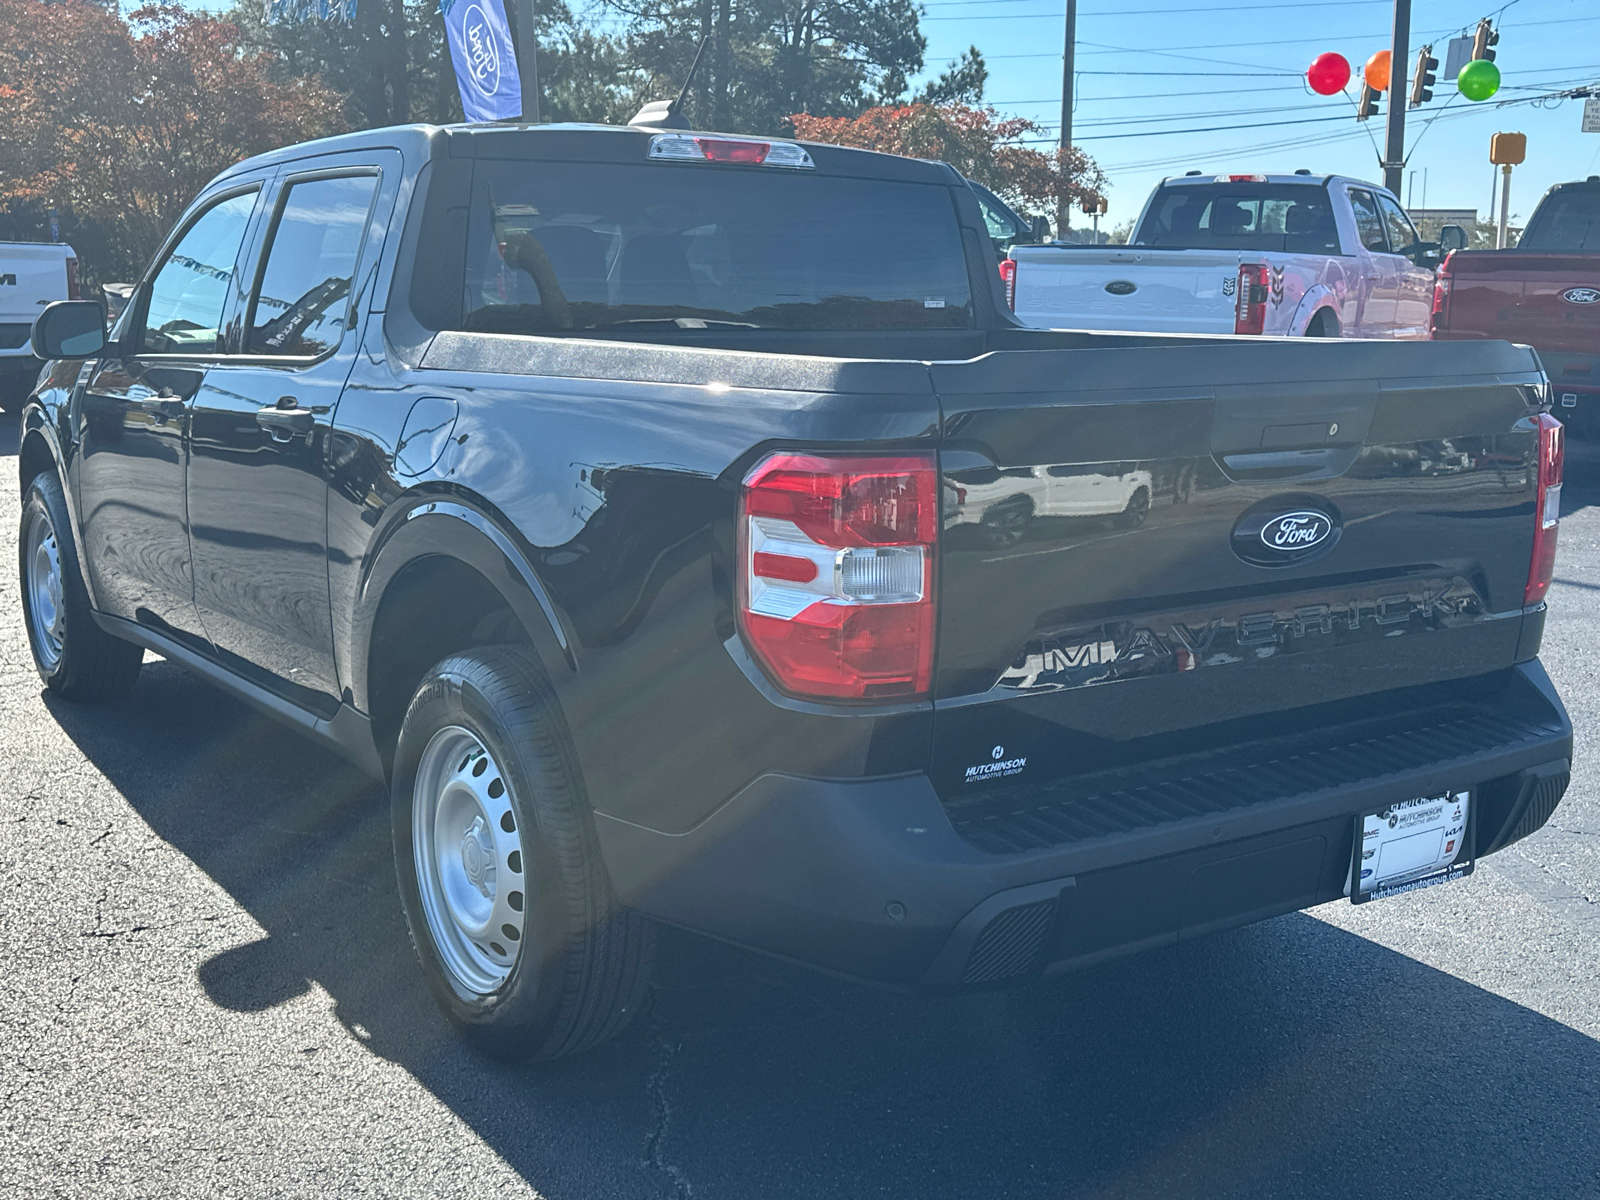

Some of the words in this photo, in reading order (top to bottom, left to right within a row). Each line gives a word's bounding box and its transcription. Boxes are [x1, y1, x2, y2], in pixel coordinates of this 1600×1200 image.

[1026, 298, 1129, 311] SUPER
[1137, 301, 1222, 312] DUTY
[1570, 290, 1597, 302] Ford
[1275, 517, 1320, 545] Ford
[1042, 583, 1457, 676] MAVERICK
[402, 678, 446, 734] ontinental
[965, 757, 1027, 777] HUTCHINSON
[965, 771, 1003, 784] AUTOMOTIVE
[1003, 767, 1024, 777] GROUP
[1399, 805, 1444, 824] HUTCHINSON
[1426, 814, 1441, 824] GROUP
[1370, 869, 1464, 900] Hutchinsonautogroup.com
